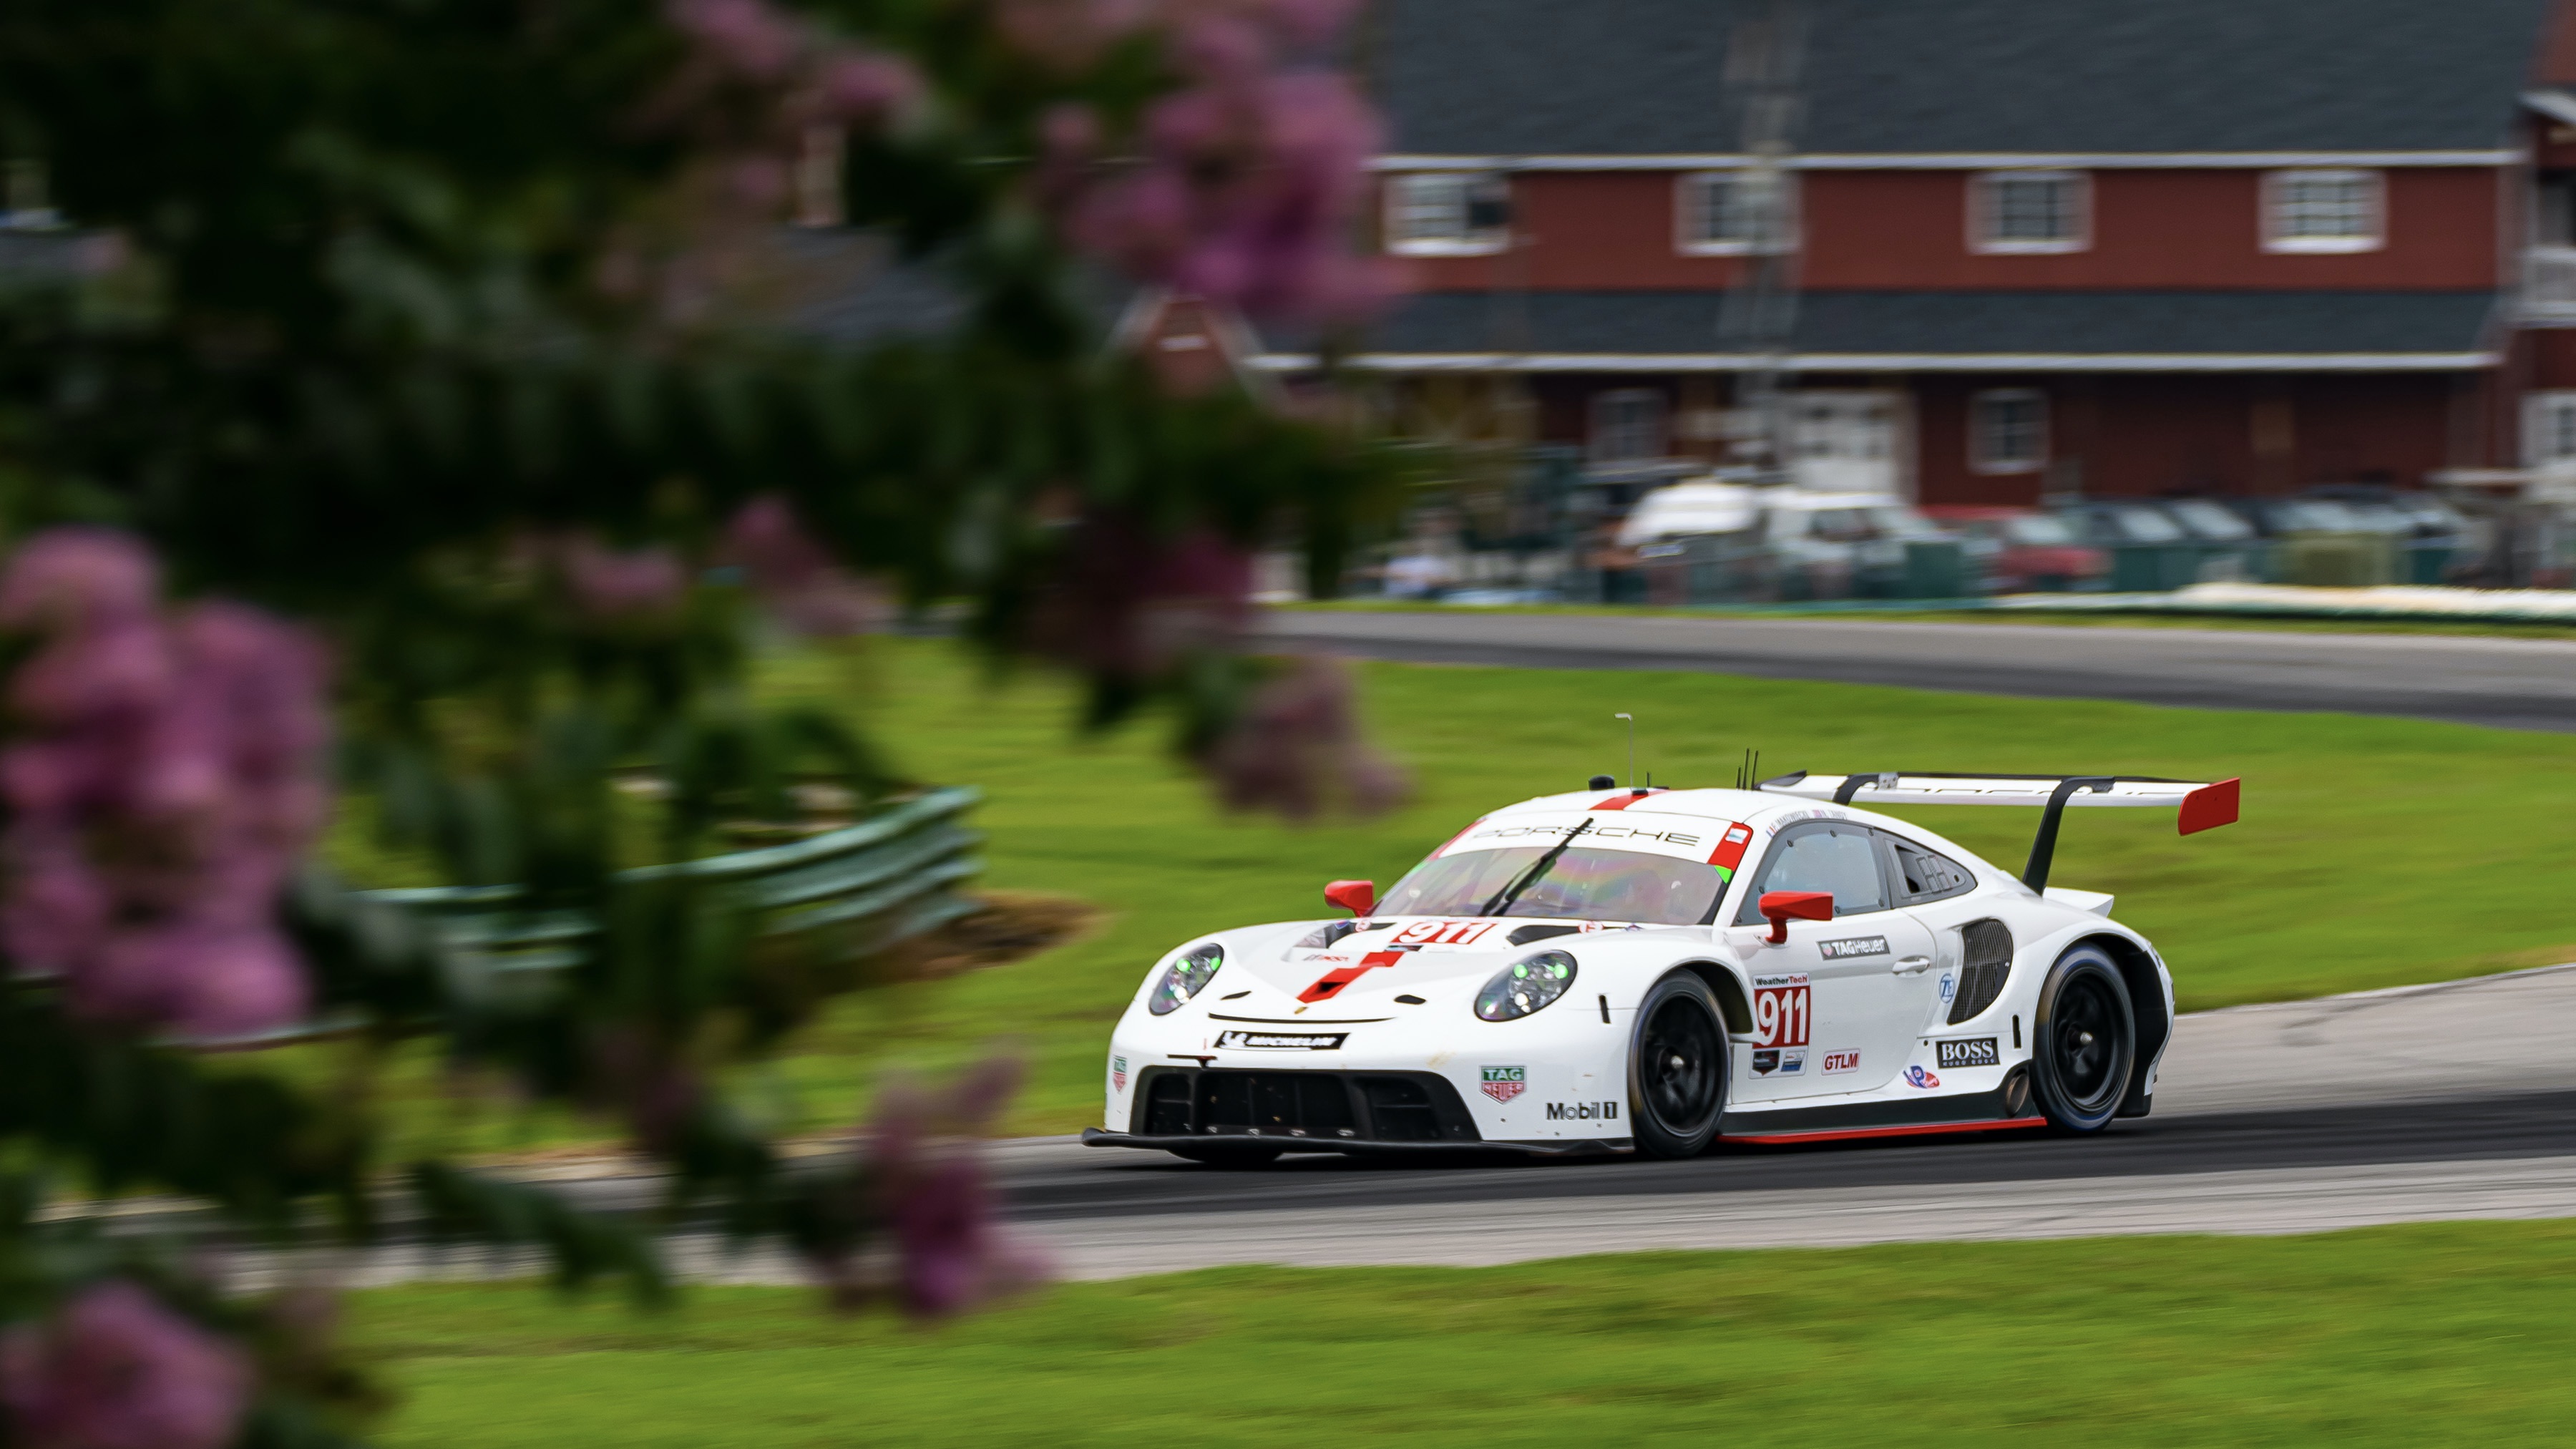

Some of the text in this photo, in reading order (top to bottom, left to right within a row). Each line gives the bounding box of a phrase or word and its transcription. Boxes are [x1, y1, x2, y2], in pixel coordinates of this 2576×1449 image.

[1399, 921, 1491, 944] 911
[1755, 975, 1807, 986] WeatherTech
[1758, 988, 1807, 1046] 911
[1941, 1040, 1994, 1060] BOSS
[1825, 1053, 1858, 1070] GTLM
[1484, 1068, 1522, 1080] TAG
[1546, 1102, 1600, 1120] Mobil
